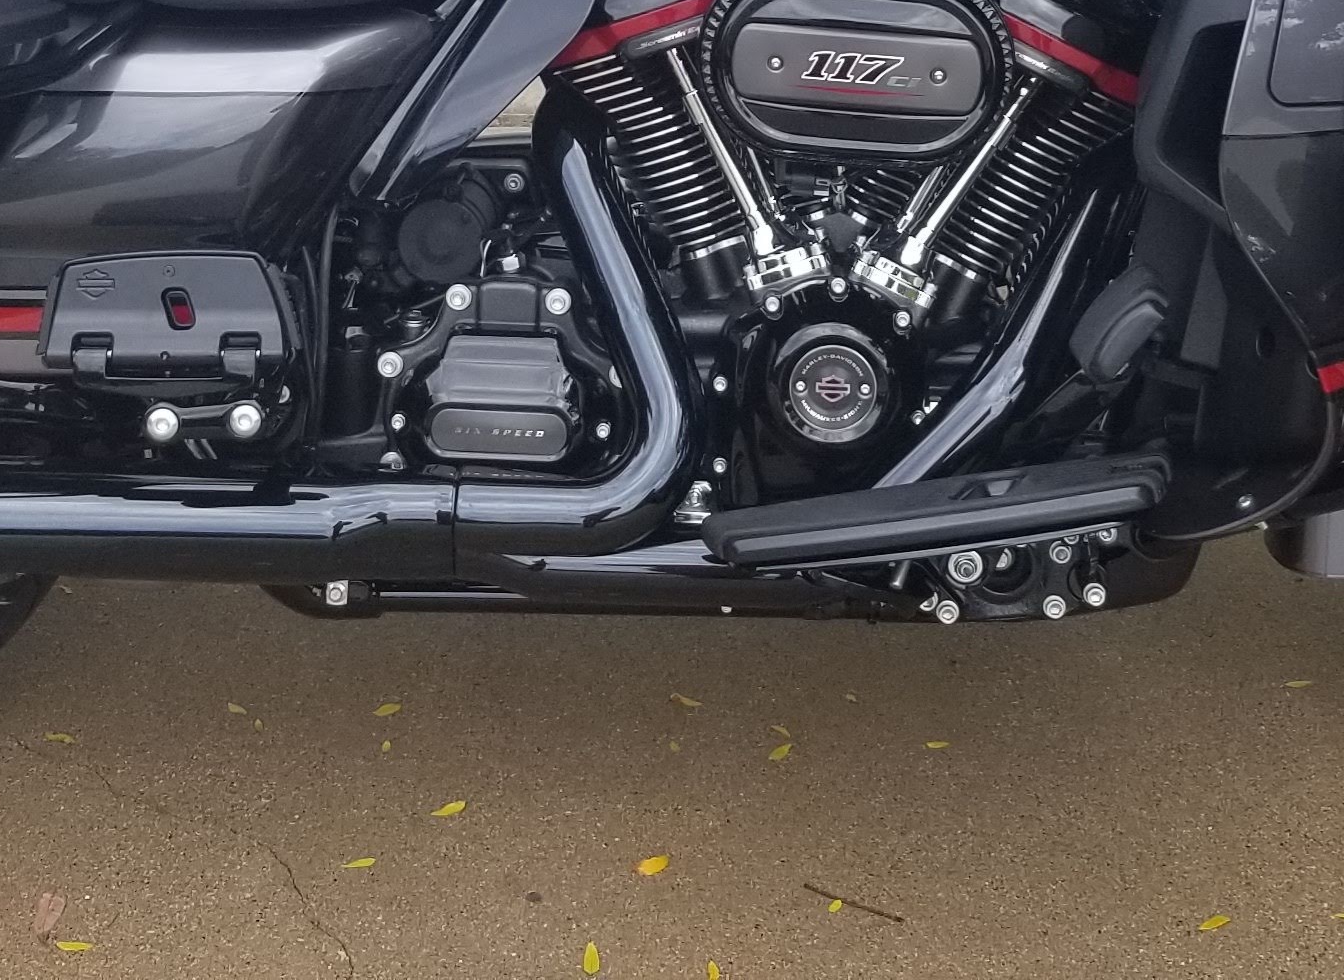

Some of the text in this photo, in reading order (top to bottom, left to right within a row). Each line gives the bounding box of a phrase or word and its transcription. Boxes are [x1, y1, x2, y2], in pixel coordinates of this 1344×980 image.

[801, 50, 904, 85] 117
[801, 354, 864, 377] HARLEY-DAVIDSON
[492, 428, 545, 437] SPEED
